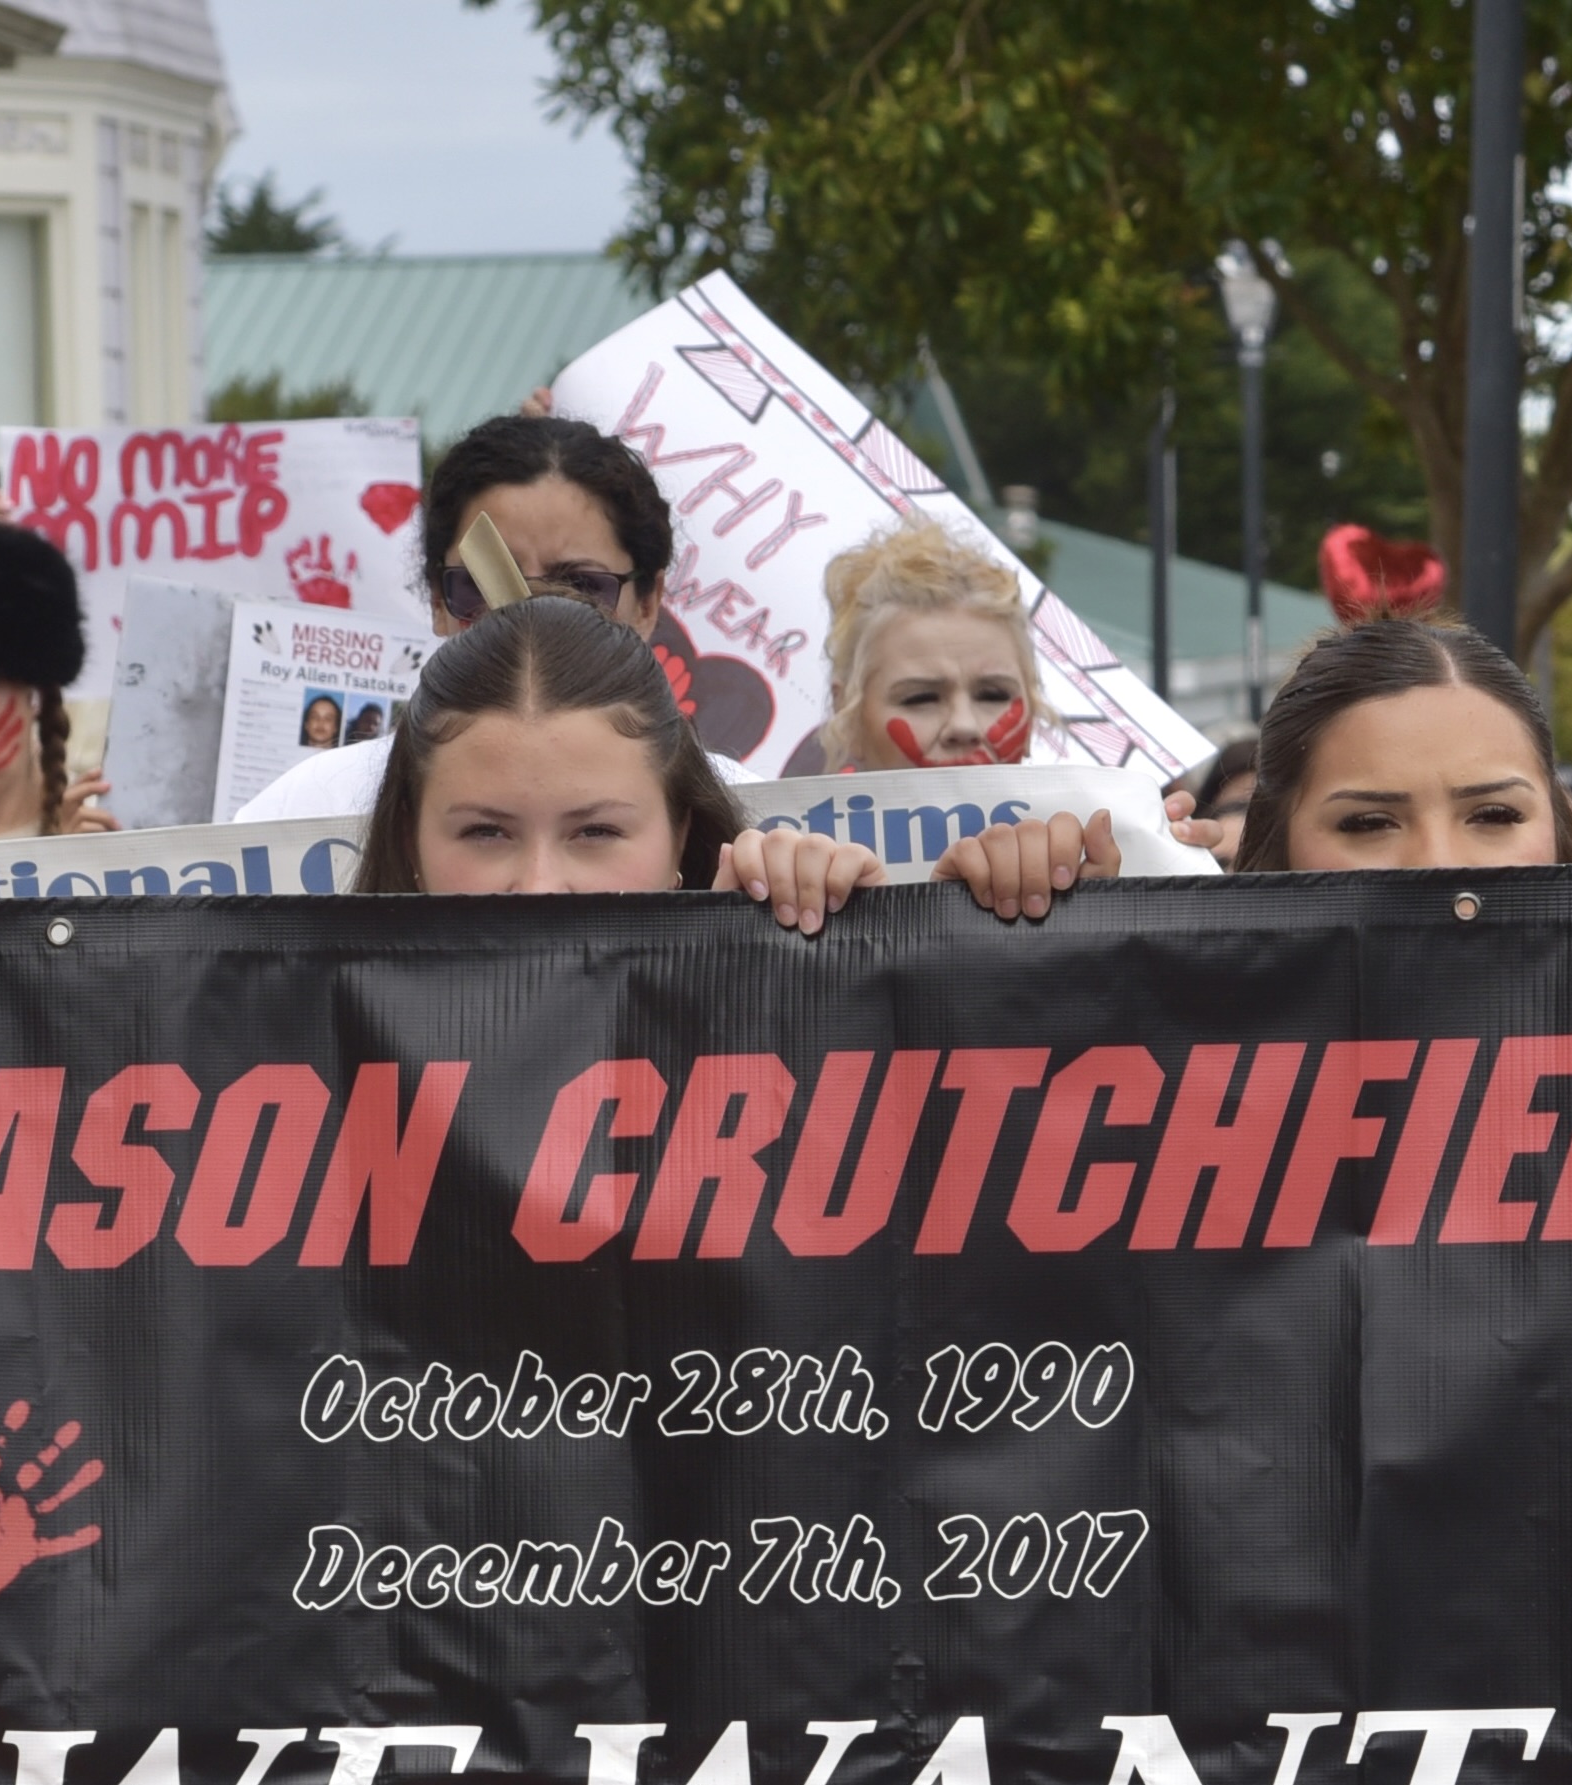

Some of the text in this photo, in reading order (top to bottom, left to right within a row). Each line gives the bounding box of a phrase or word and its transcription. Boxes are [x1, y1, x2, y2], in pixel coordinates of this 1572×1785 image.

[8, 422, 285, 509] NO MORE
[613, 360, 828, 571] WHY
[20, 483, 289, 572] MMIP
[260, 660, 291, 681] Roy
[295, 665, 338, 685] Allen
[291, 643, 381, 671] PERSON
[292, 622, 384, 653] MISSING
[300, 1341, 1135, 1442] October 28th, 1990
[292, 1509, 1150, 1611] December 7th, 2017
